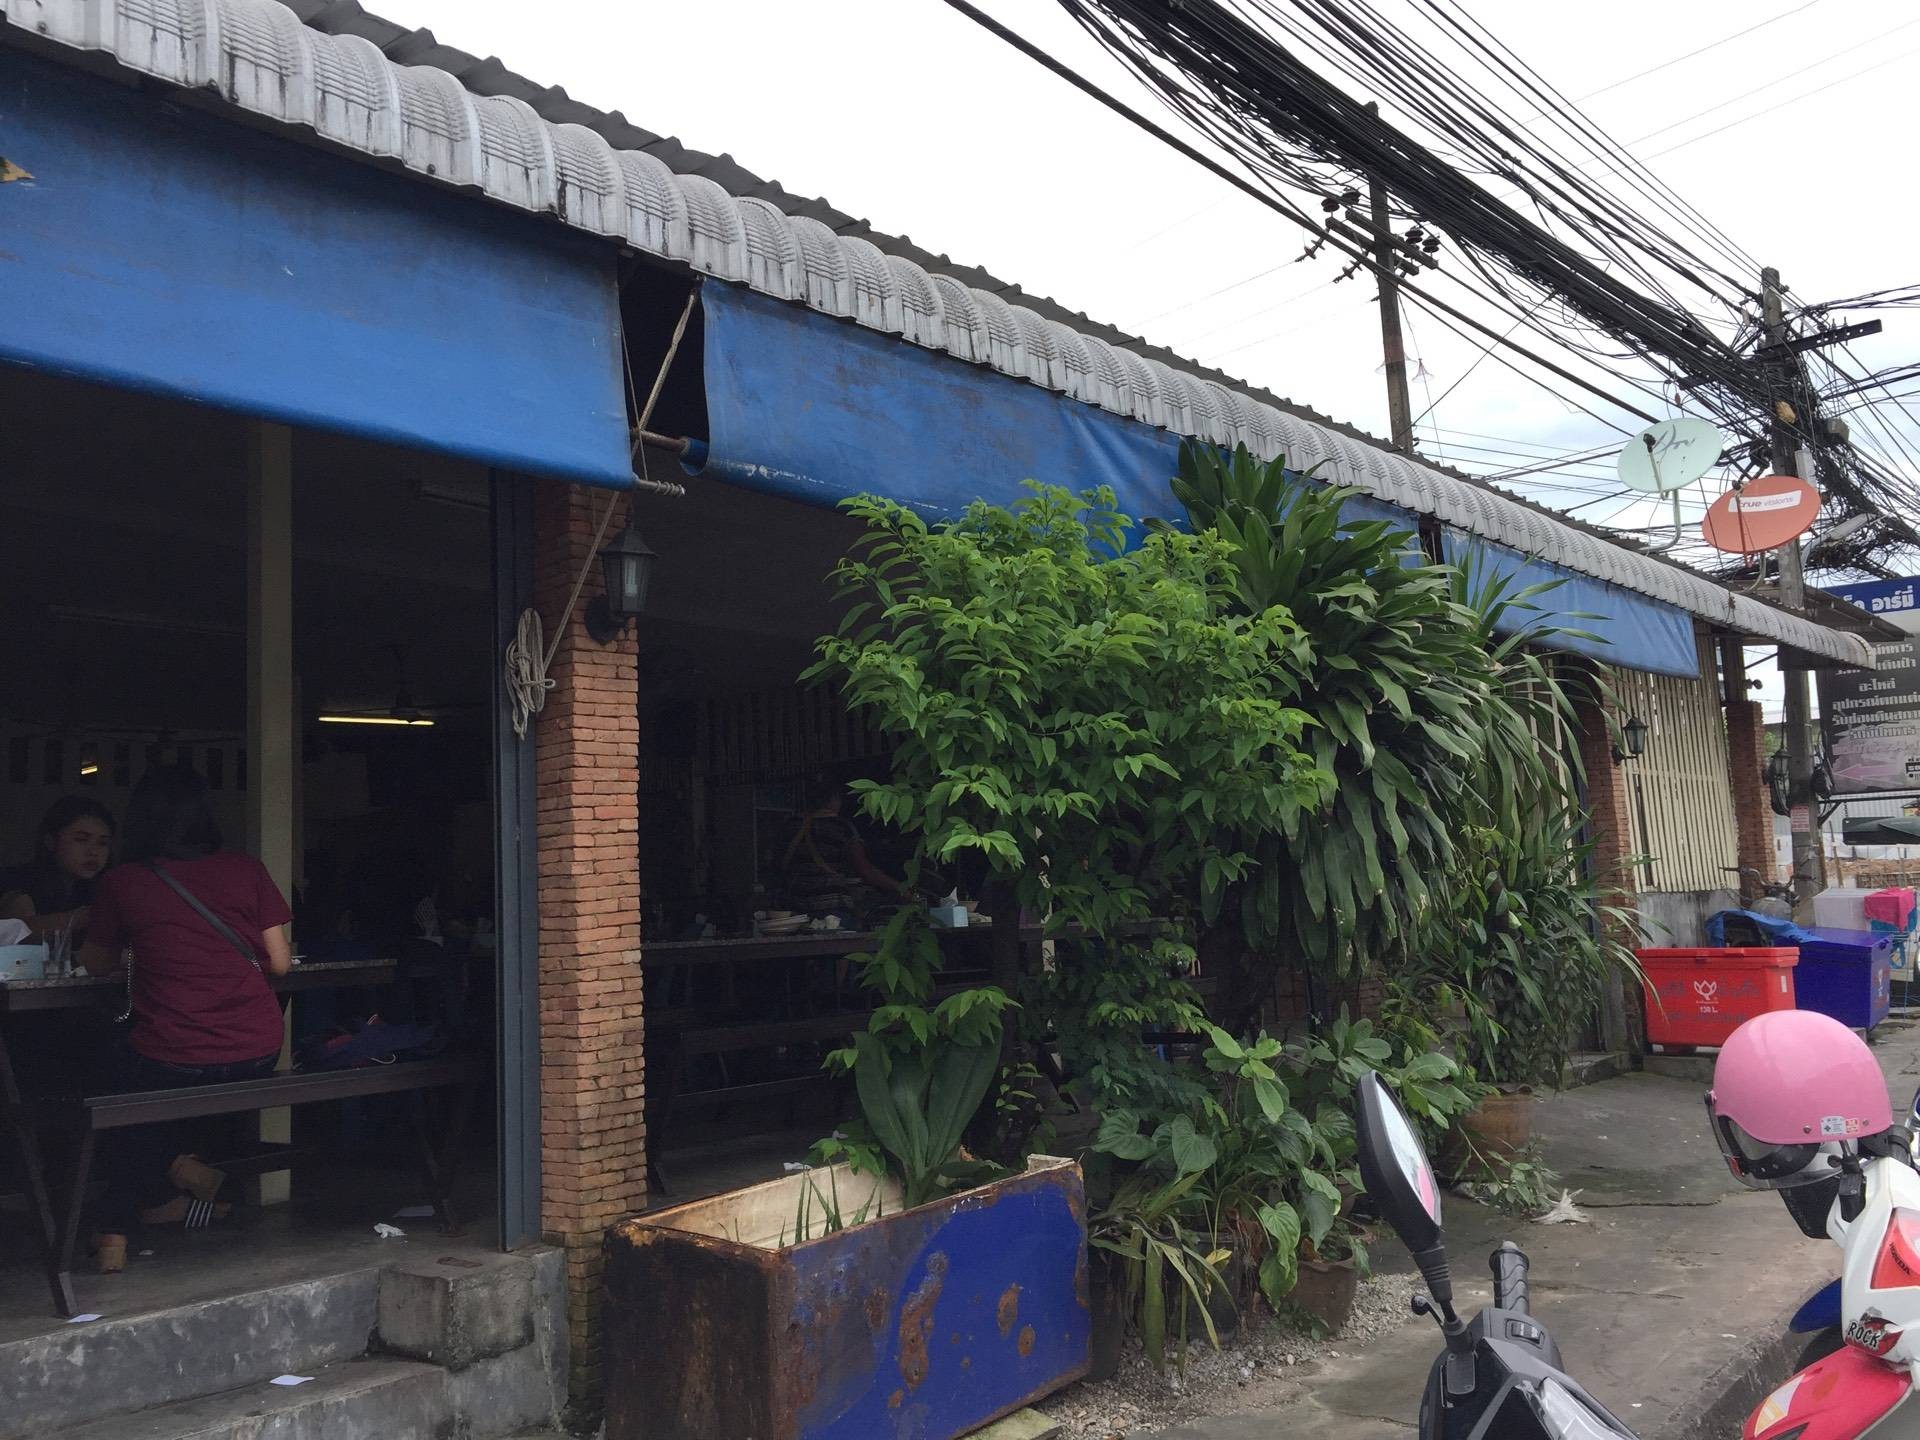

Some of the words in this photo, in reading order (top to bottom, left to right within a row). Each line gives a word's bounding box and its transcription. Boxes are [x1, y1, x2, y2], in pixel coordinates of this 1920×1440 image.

[1872, 585, 1914, 612] อาร์มี่
[1858, 677, 1896, 692] อะไหล่
[1889, 1241, 1911, 1275] HONDA
[1847, 1321, 1881, 1348] ROCK
